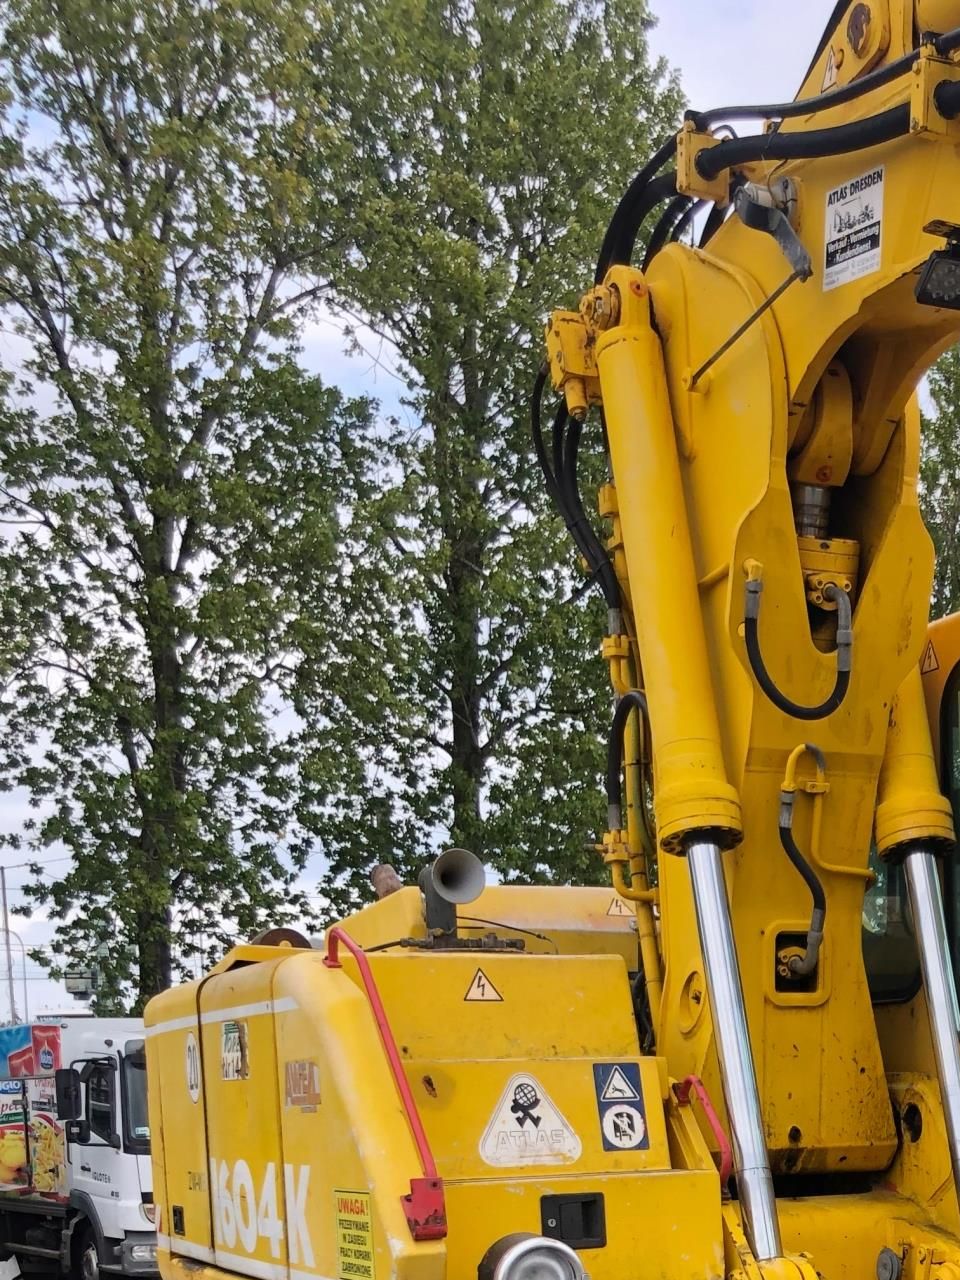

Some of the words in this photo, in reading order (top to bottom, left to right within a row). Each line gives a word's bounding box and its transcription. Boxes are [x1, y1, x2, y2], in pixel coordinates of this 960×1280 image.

[828, 186, 848, 207] ATLAS
[850, 169, 883, 196] DRESDEN
[187, 1045, 199, 1091] 20
[495, 1129, 566, 1153] ATLAS
